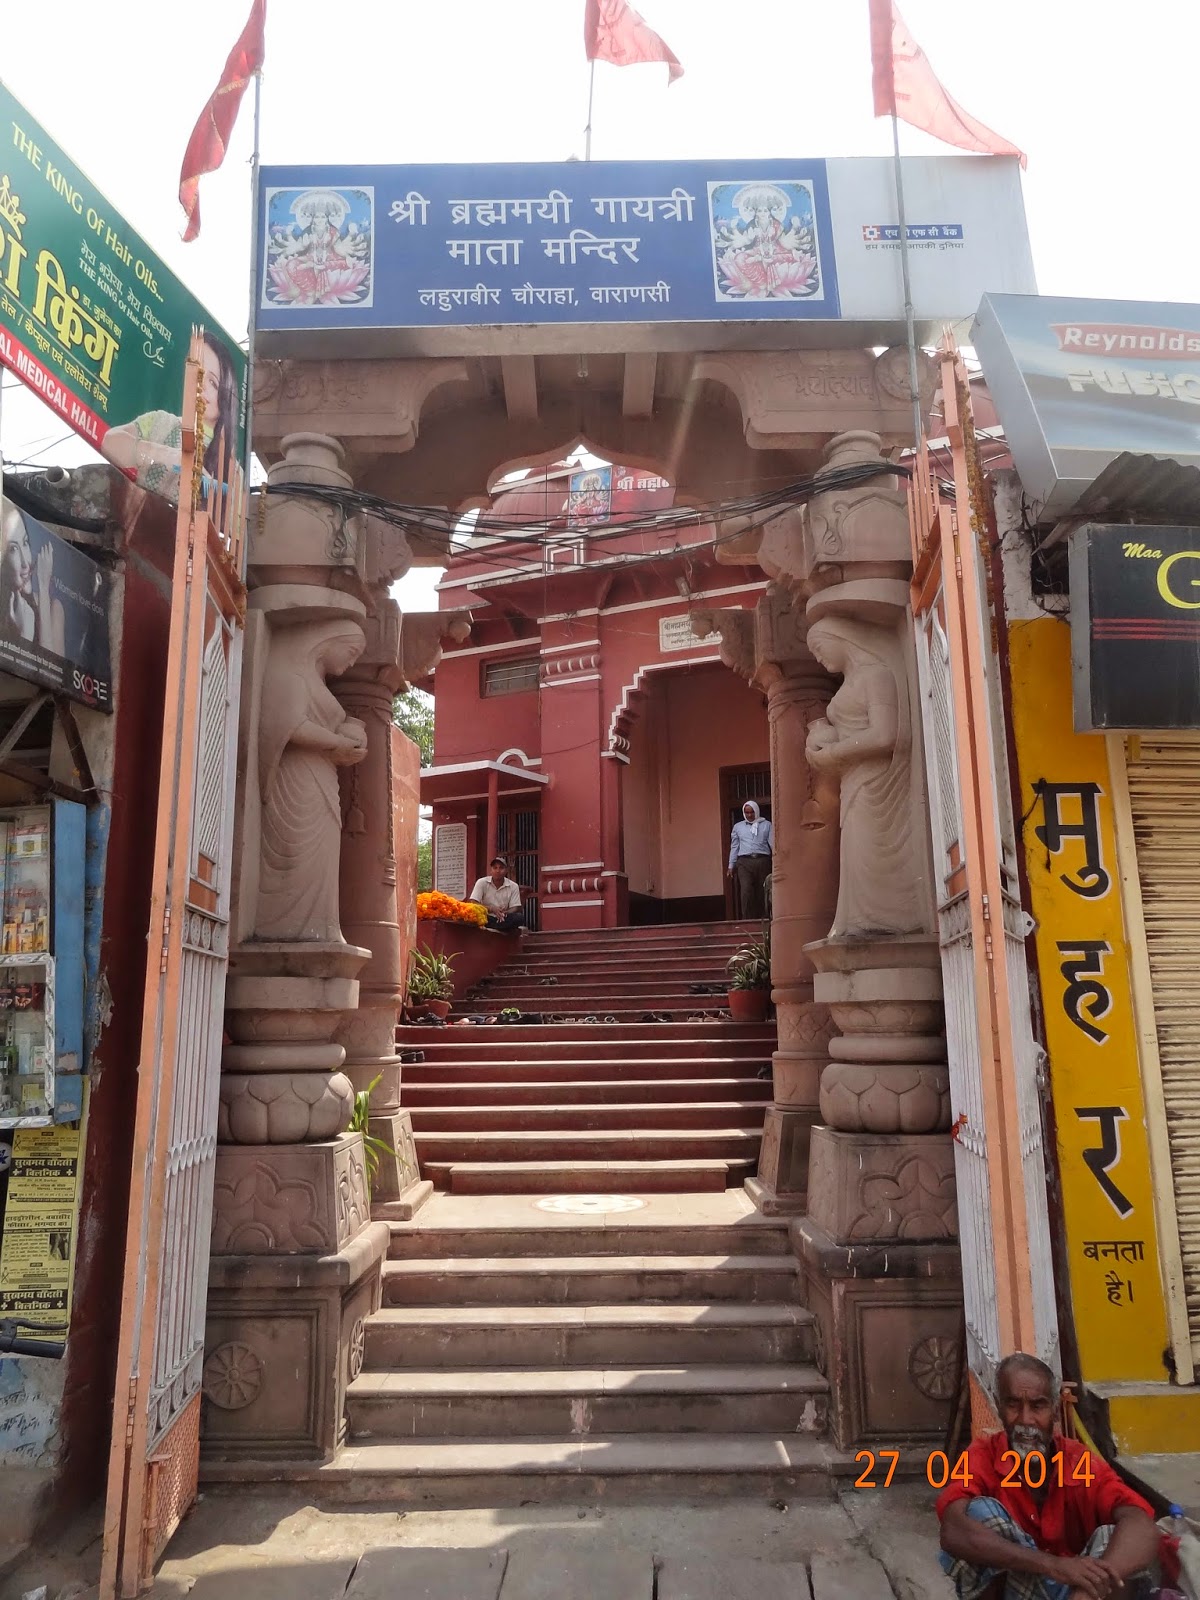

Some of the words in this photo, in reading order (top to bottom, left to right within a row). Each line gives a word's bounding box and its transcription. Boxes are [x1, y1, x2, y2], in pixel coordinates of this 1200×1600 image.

[12, 121, 42, 171] THE
[46, 161, 83, 215] KING
[86, 208, 106, 236] Of
[105, 226, 134, 268] Hair
[387, 191, 431, 226] श्री
[448, 189, 573, 227] ब्रह्ममयी
[591, 187, 696, 223] गायत्री
[446, 239, 523, 266] माता
[541, 228, 641, 265] मन्दिर
[928, 226, 939, 237] सी
[942, 226, 958, 236] बैंक
[79, 257, 96, 282] THE
[97, 276, 119, 302] KING
[418, 283, 501, 311] लहुराबीर
[511, 281, 579, 307] चौराहा,
[589, 280, 671, 304] वाराणसी
[1, 293, 17, 320] तेल
[33, 249, 120, 387] किंग
[1063, 327, 1200, 352] Reynolds
[17, 348, 69, 414] MEDICAL
[71, 405, 99, 442] HALL
[1122, 543, 1163, 558] Maa
[1082, 1240, 1145, 1265] बनता
